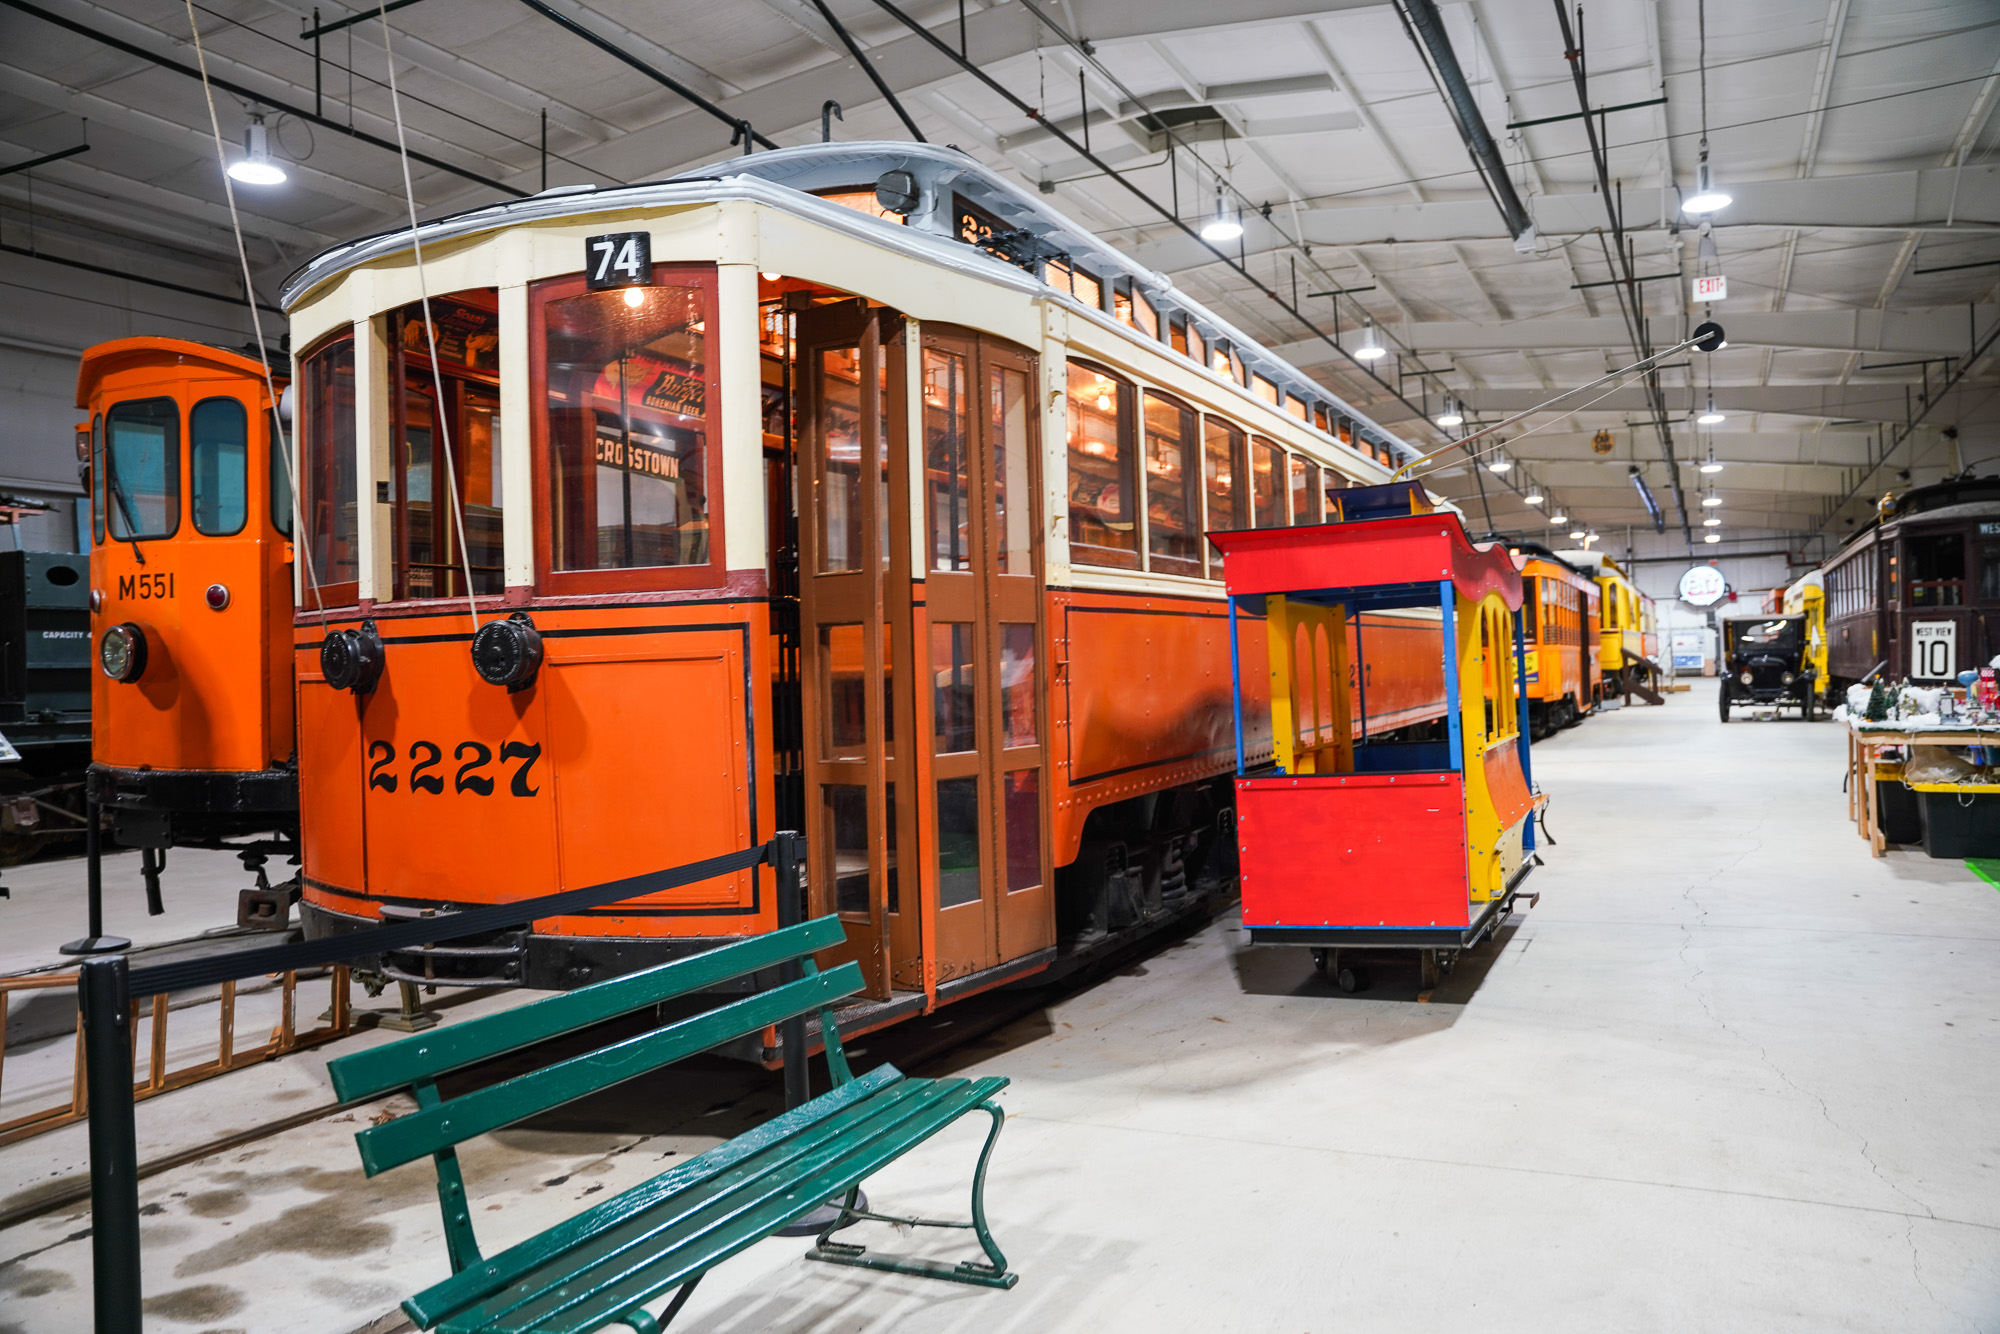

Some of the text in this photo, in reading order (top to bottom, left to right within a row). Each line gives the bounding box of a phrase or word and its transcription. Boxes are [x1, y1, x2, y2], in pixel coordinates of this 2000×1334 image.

[592, 240, 641, 281] 74
[1699, 277, 1721, 294] EXIT
[645, 395, 700, 417] BOHEMIAN BEER
[595, 437, 680, 479] CROSSTOWN
[119, 573, 175, 600] M551
[42, 631, 84, 639] CAPACITY
[1916, 627, 1952, 636] WEST VIEW
[1918, 640, 1949, 677] 10
[368, 739, 542, 797] 2227
